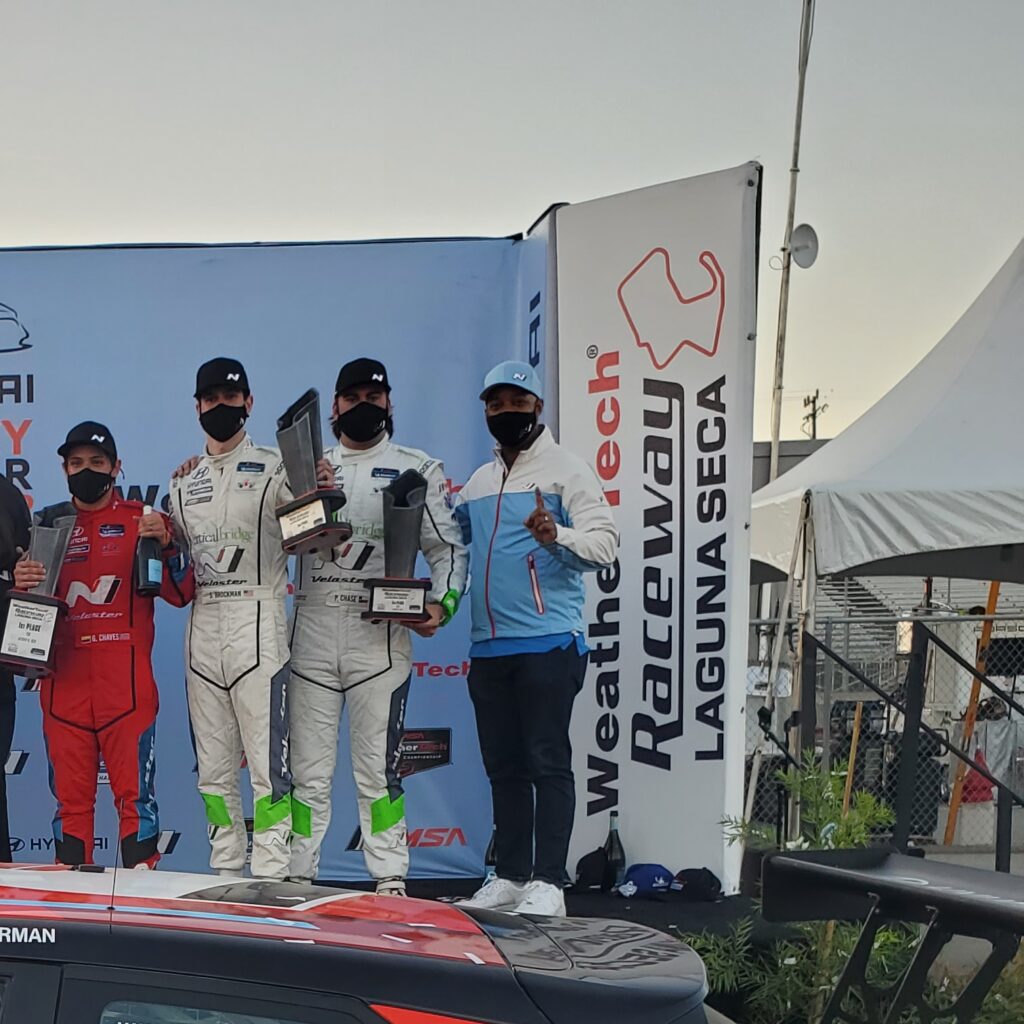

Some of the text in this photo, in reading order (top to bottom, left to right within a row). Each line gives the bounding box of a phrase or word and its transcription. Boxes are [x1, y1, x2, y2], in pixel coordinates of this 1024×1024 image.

[630, 378, 685, 771] Raceway
[694, 374, 727, 762] LAGUNA SECA
